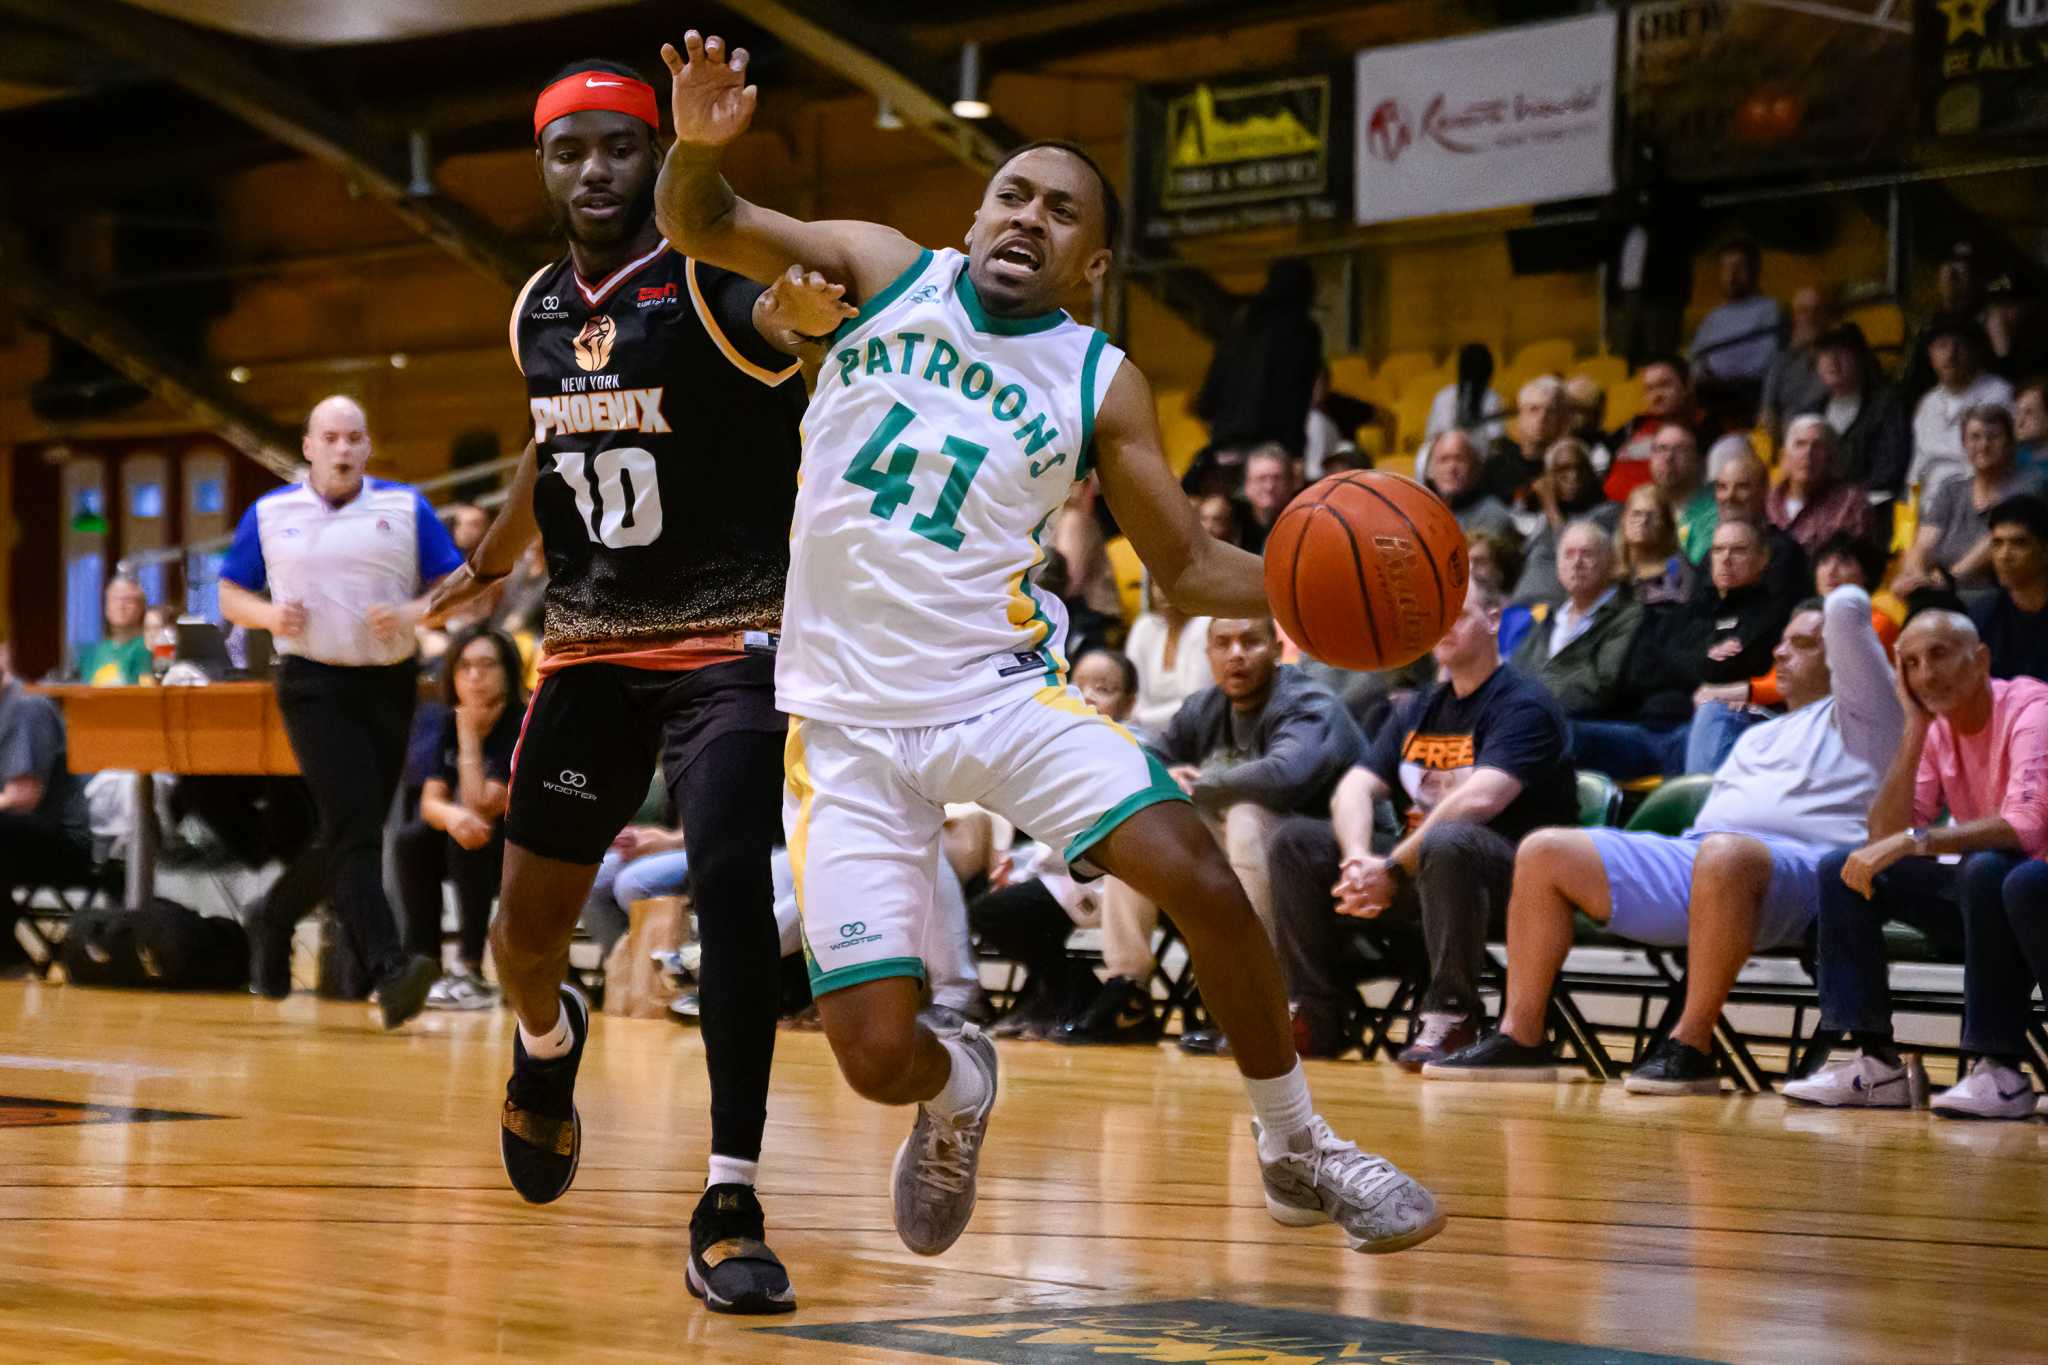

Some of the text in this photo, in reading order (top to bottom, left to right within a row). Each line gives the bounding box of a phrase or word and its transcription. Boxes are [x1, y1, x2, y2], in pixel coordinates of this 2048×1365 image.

[530, 311, 569, 320] WOOTER
[561, 373, 620, 393] NEW YORK
[530, 386, 673, 444] PHOENIX
[836, 332, 1067, 480] PATROONS
[842, 402, 990, 552] 41
[552, 447, 663, 549] 10
[543, 780, 598, 801] WOOTER
[829, 934, 882, 951] WOOTER
